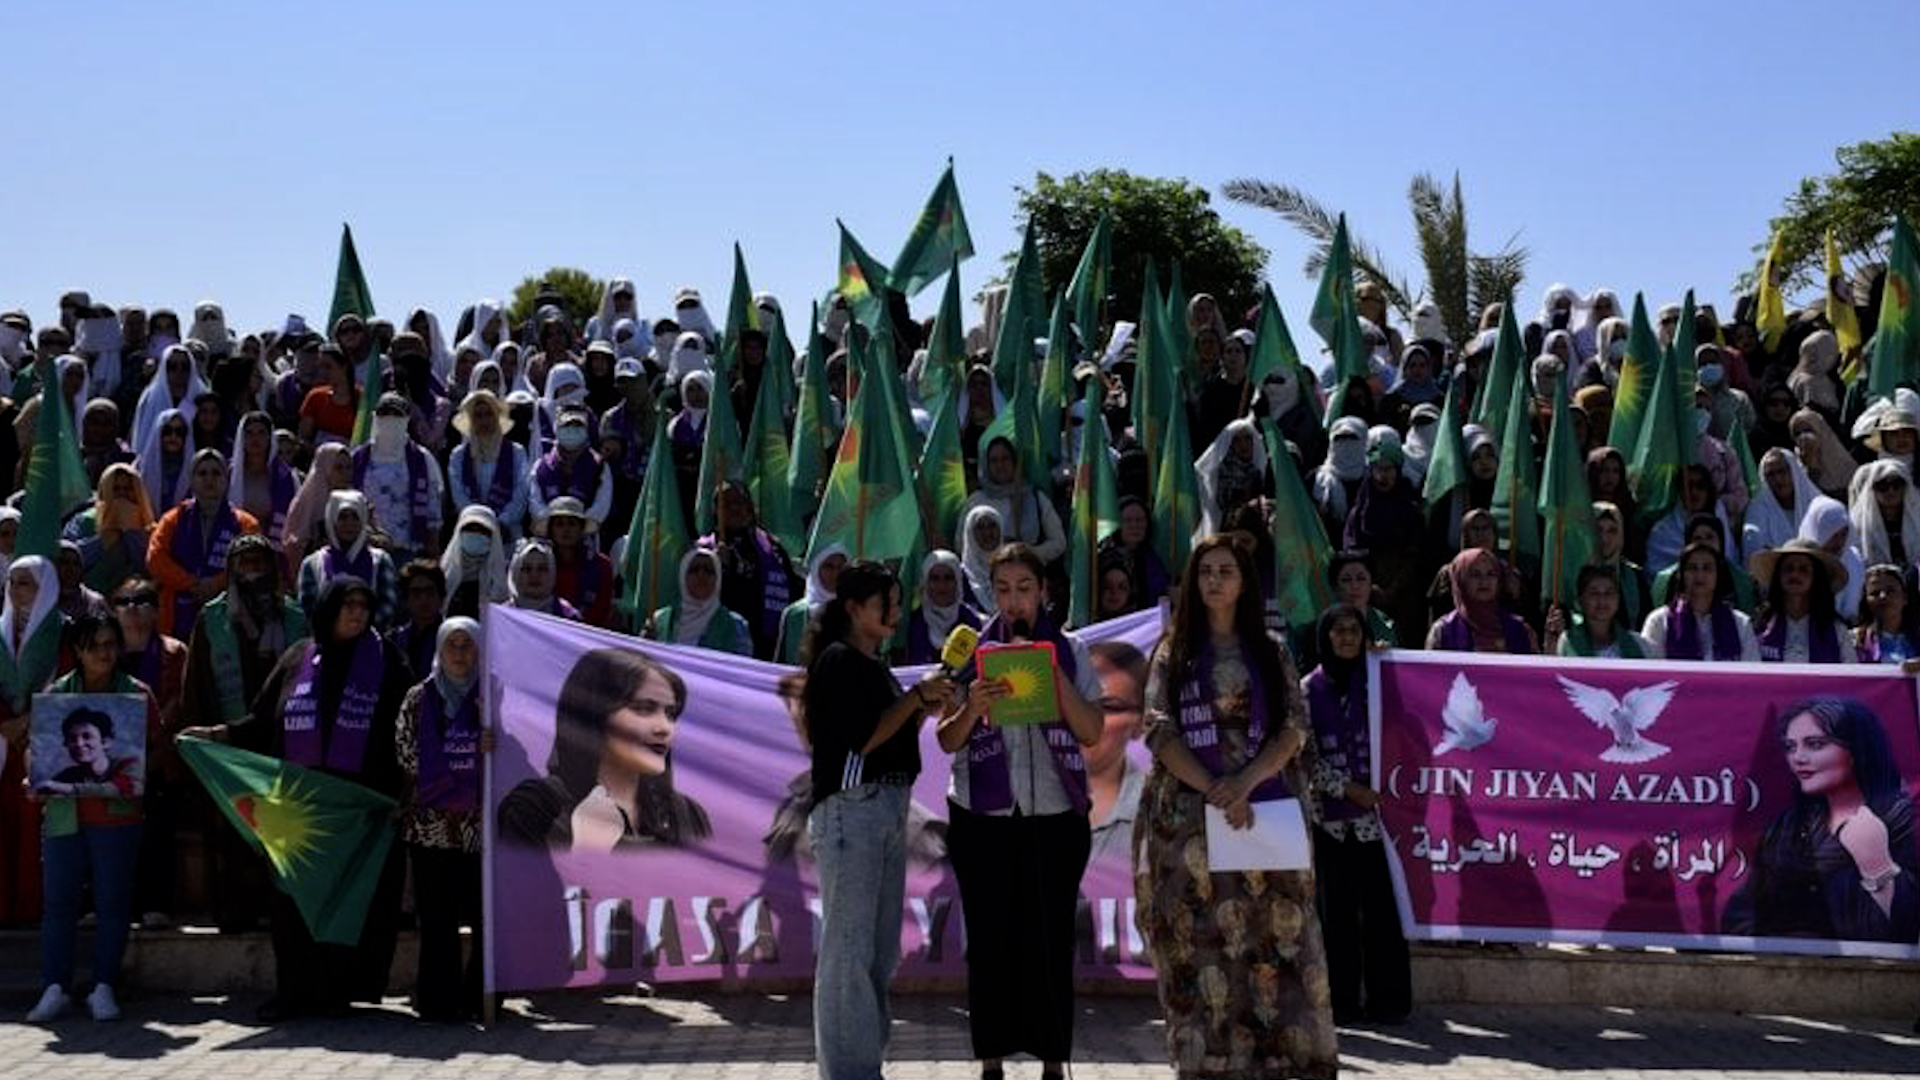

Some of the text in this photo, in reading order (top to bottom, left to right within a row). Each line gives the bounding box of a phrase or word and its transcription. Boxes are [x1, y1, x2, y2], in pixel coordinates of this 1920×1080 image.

[1411, 766, 1474, 796] JIN
[1484, 769, 1596, 799] JIYAN
[1610, 768, 1735, 804] AZADÎ
[1411, 825, 1517, 872] الحرية
[1548, 832, 1620, 877] حياة
[1653, 830, 1724, 880] المرأة
